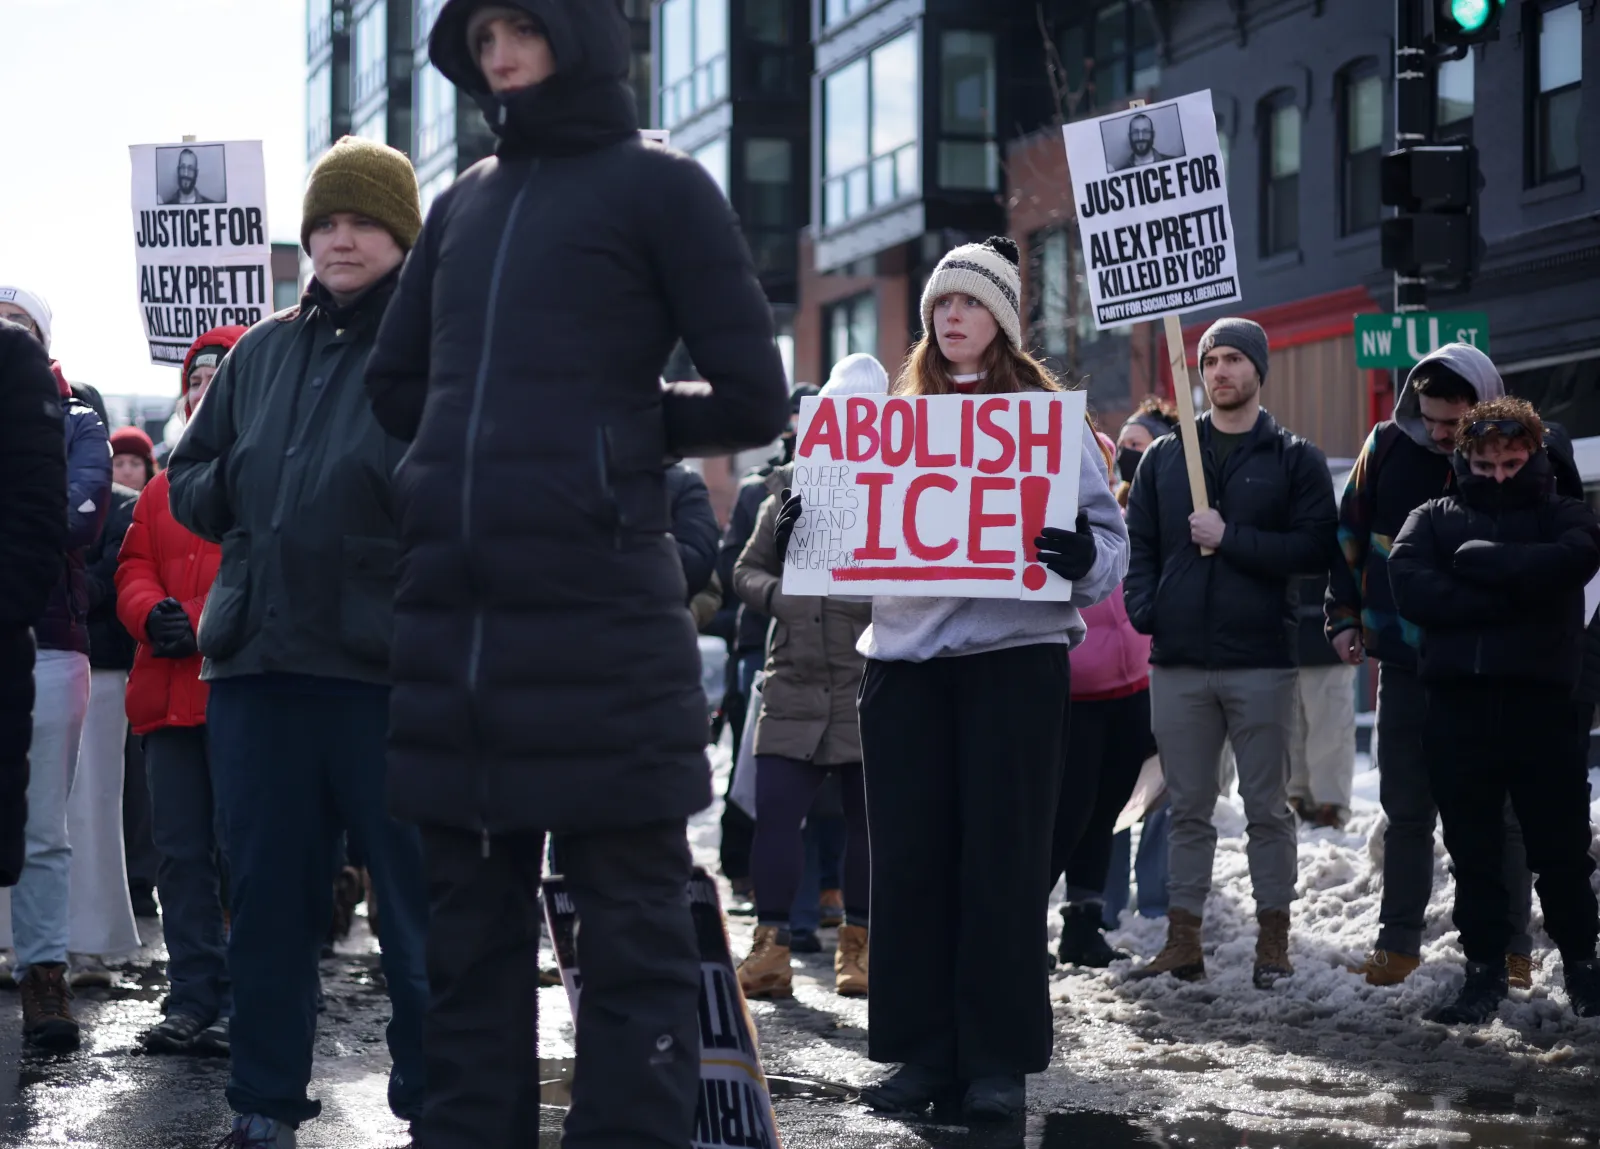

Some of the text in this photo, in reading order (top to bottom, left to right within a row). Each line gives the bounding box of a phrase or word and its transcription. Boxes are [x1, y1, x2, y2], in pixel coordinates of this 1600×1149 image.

[1081, 154, 1221, 218] JUSTICE FOR
[137, 207, 264, 248] JUSTICE FOR
[1089, 204, 1228, 269] ALEX PRETTI
[140, 264, 265, 305] ALEX PRETTI
[1097, 244, 1226, 299] KILLED BY CBP
[145, 306, 193, 338] KILLED
[196, 307, 218, 337] BY
[1099, 281, 1234, 322] PARTY FOR SOCIALISM & LIBERATION
[1362, 330, 1392, 357] NW
[1406, 317, 1440, 361] U
[798, 397, 1063, 475] ABOLISH
[795, 464, 850, 487] QUEER
[799, 487, 859, 509] ALLIES
[793, 529, 843, 549] WITH
[794, 509, 857, 531] STAND
[854, 472, 1052, 591] ICE!
